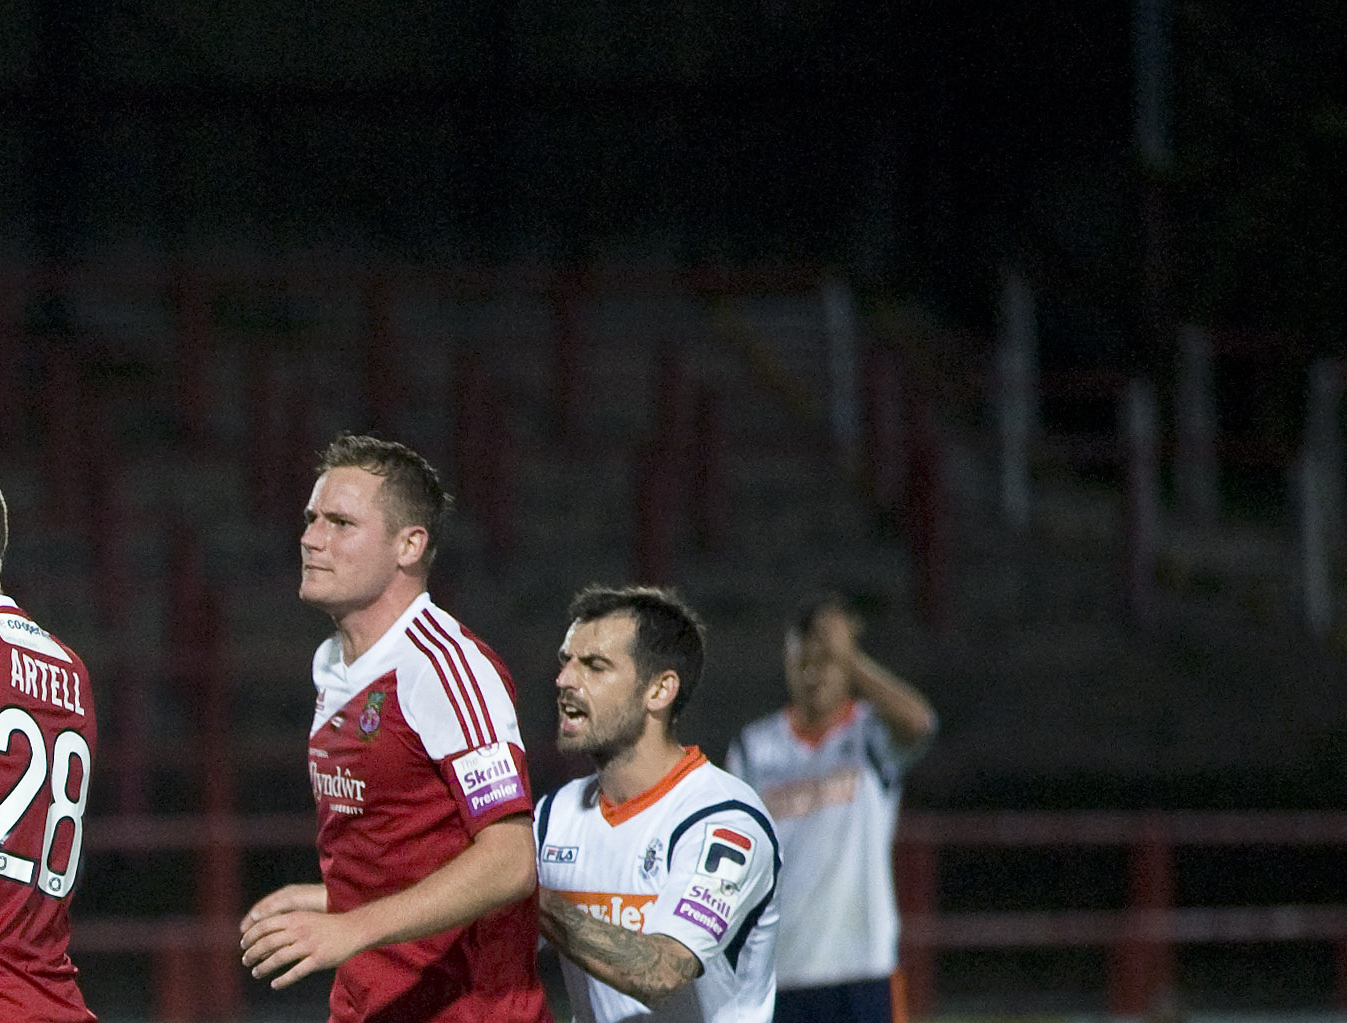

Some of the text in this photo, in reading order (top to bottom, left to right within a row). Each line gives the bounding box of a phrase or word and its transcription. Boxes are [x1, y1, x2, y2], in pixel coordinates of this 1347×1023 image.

[10, 648, 85, 716] ARTELL
[464, 758, 511, 789] Skrill
[471, 783, 518, 810] Premier
[546, 848, 574, 861] FILA
[689, 886, 731, 918] Skrill
[679, 902, 724, 936] Premier
